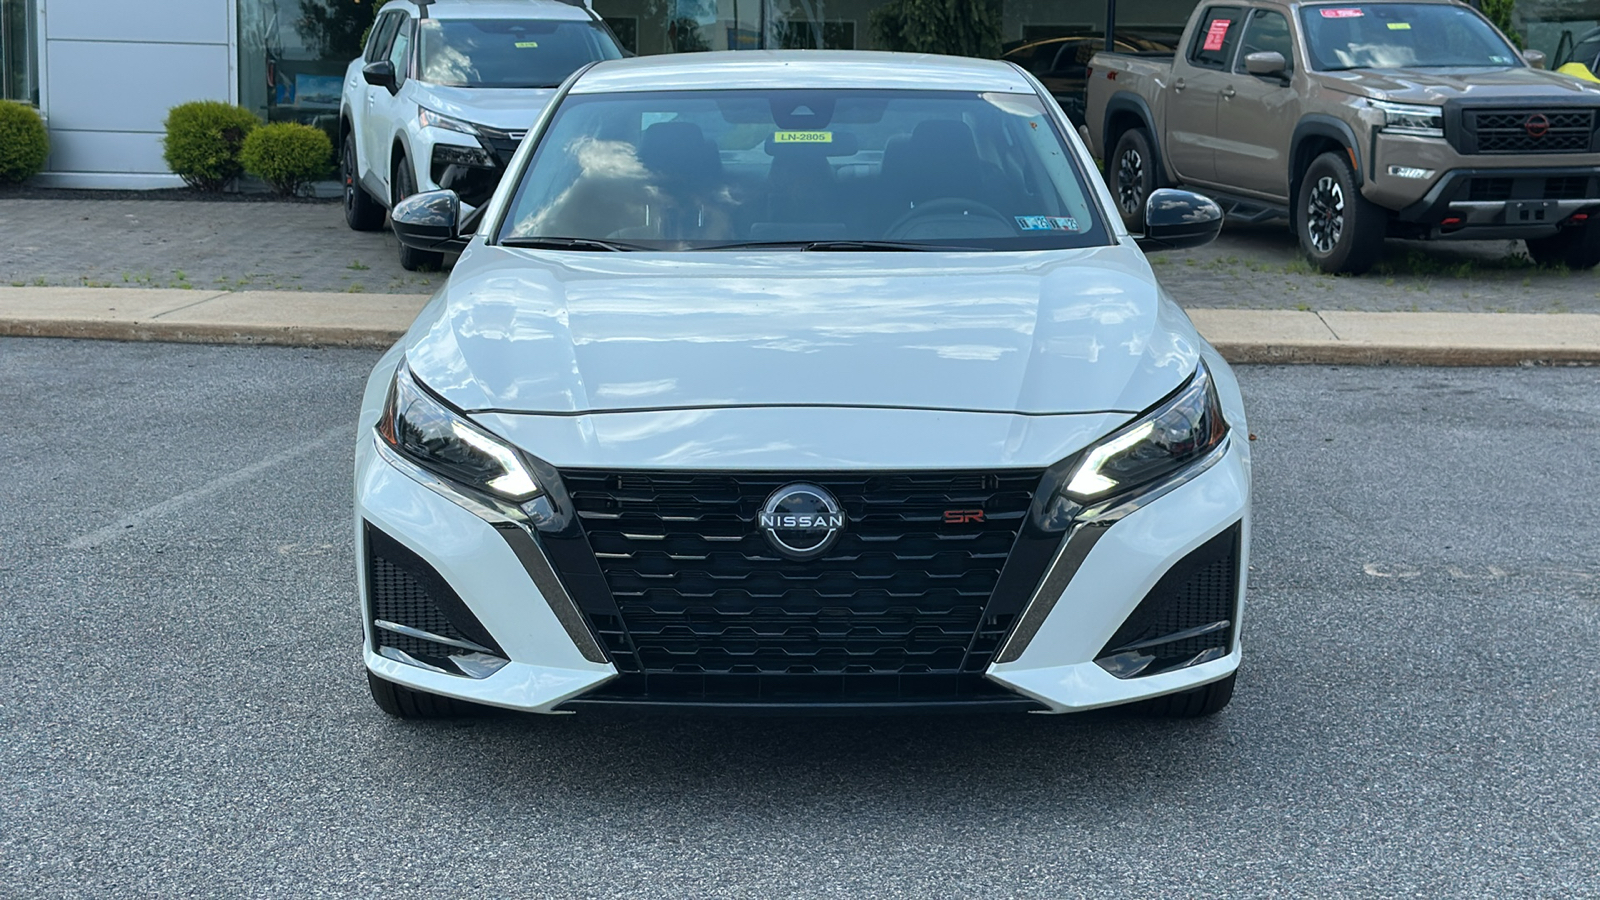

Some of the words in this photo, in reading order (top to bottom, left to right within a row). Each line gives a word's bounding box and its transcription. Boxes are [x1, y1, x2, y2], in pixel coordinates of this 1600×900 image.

[781, 133, 826, 141] LN-2805
[761, 515, 842, 527] NISSAN
[944, 509, 985, 523] SR
